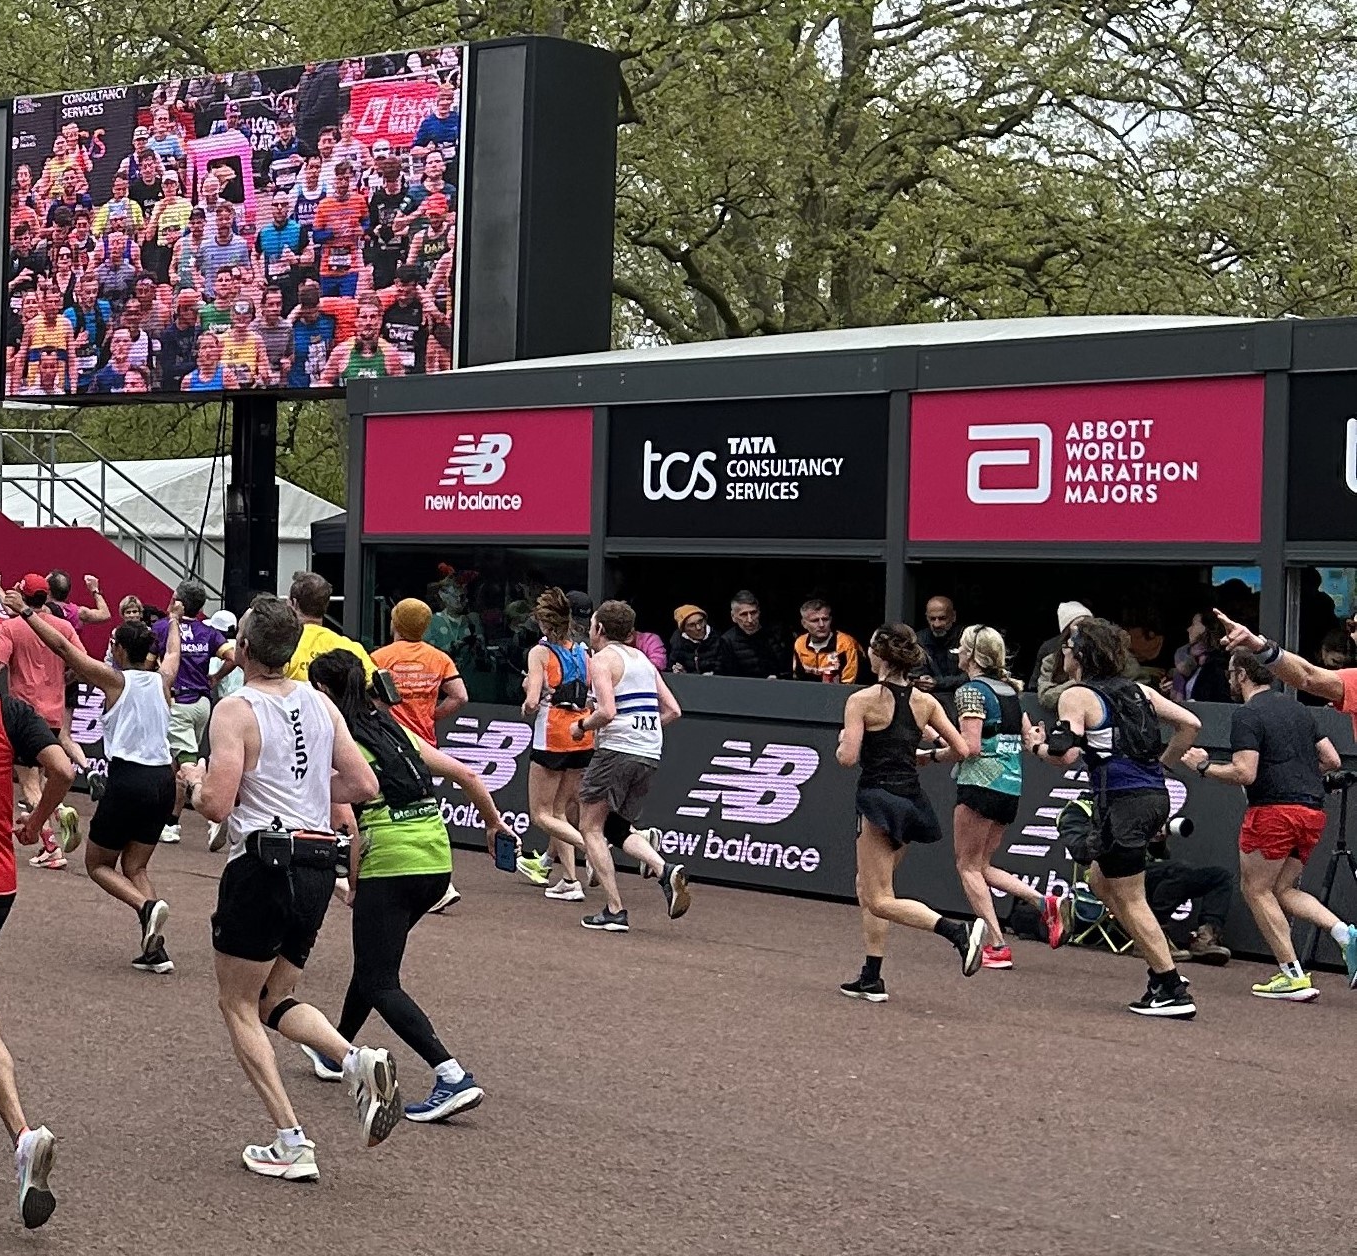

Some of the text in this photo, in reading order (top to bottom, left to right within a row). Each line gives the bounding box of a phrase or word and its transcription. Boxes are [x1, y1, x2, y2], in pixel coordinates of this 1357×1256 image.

[62, 87, 129, 105] CONSULTANCY
[62, 103, 104, 119] SERVICES
[1065, 420, 1154, 440] ABBOTT
[728, 437, 776, 454] TATA
[1064, 442, 1145, 461] WORLD
[643, 440, 716, 500] tcs
[727, 458, 843, 477] CONSULTANCY
[1064, 461, 1199, 483] MARATHON
[726, 482, 798, 500] SERVICES
[1063, 484, 1159, 504] MAJORS
[424, 492, 522, 511] new balance
[632, 715, 658, 731] JAX
[703, 828, 820, 873] balance
